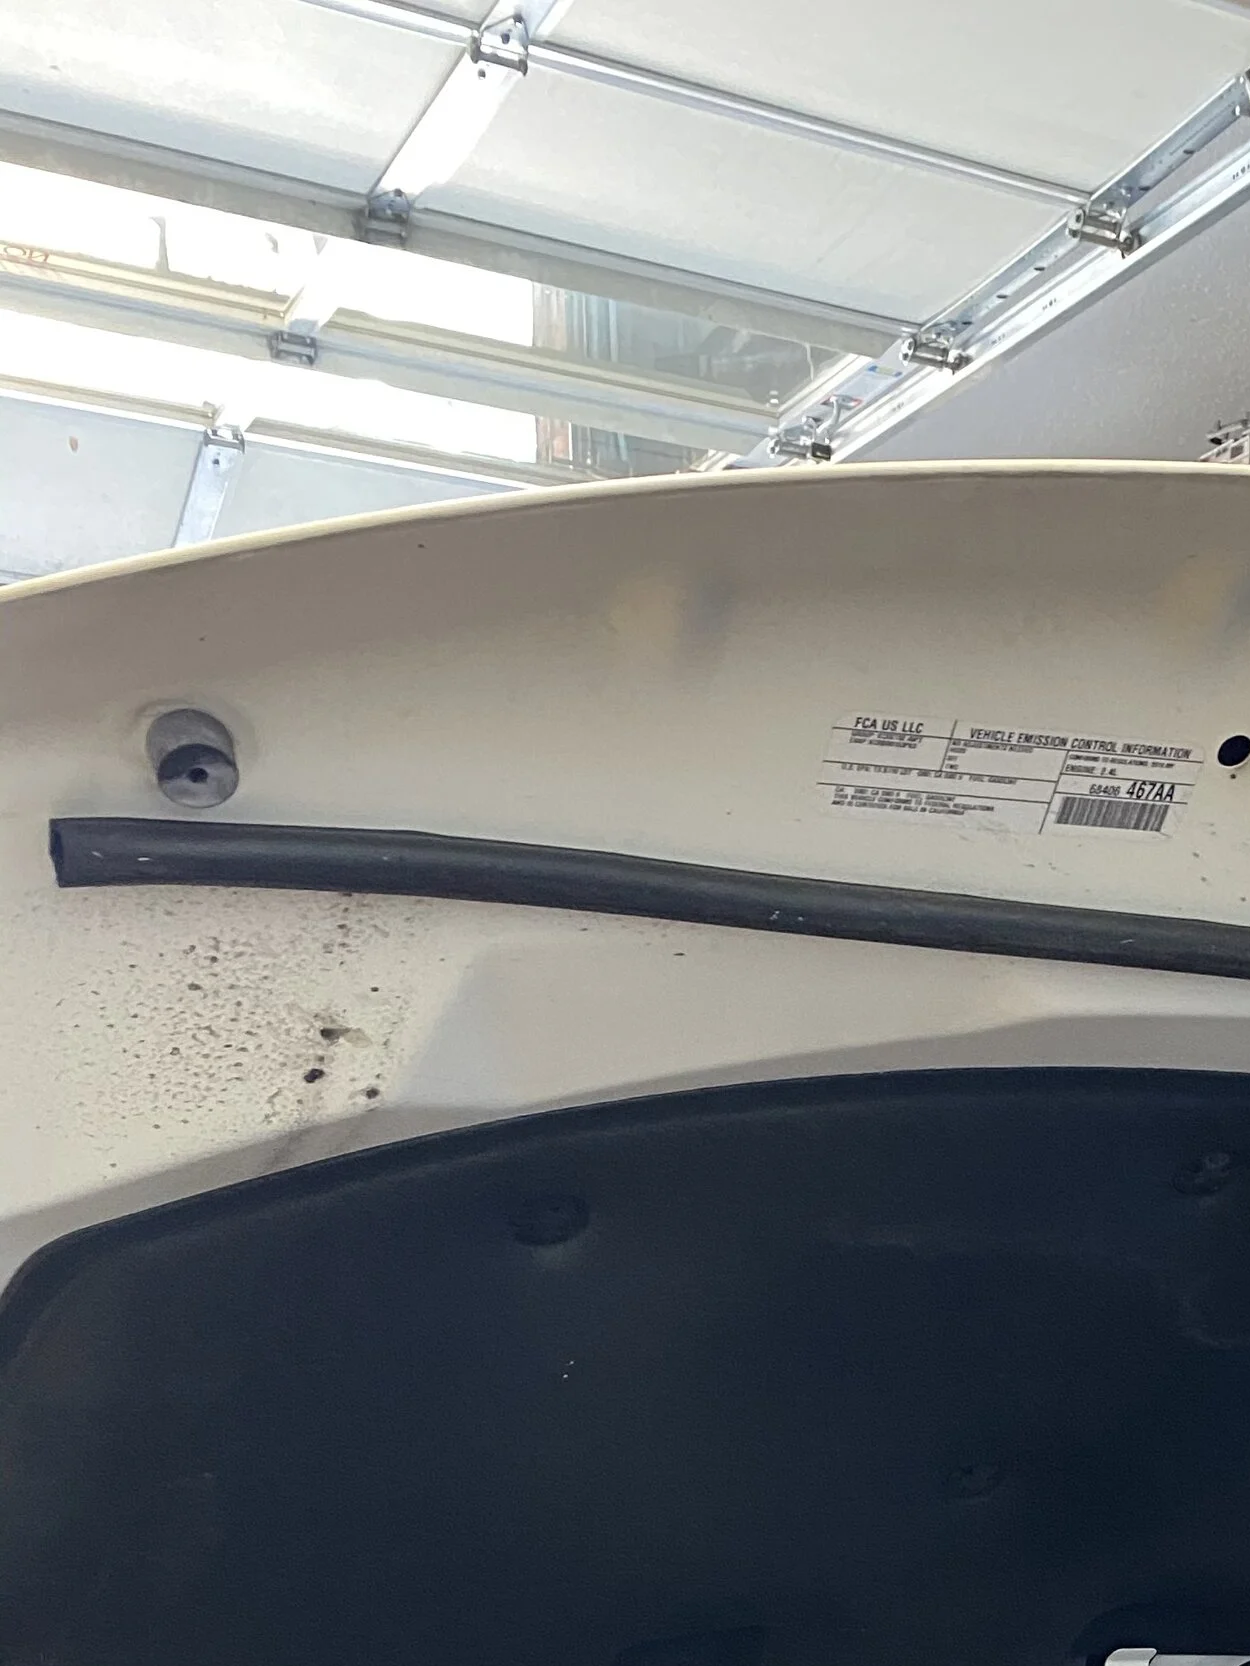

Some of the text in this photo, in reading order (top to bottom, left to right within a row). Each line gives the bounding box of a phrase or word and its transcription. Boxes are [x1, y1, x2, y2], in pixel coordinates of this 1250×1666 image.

[854, 716, 924, 734] FCA US LLC
[970, 727, 1192, 759] VEHICLE EMISSION CONTROL INFORMATION
[1126, 780, 1175, 801] 467AA
